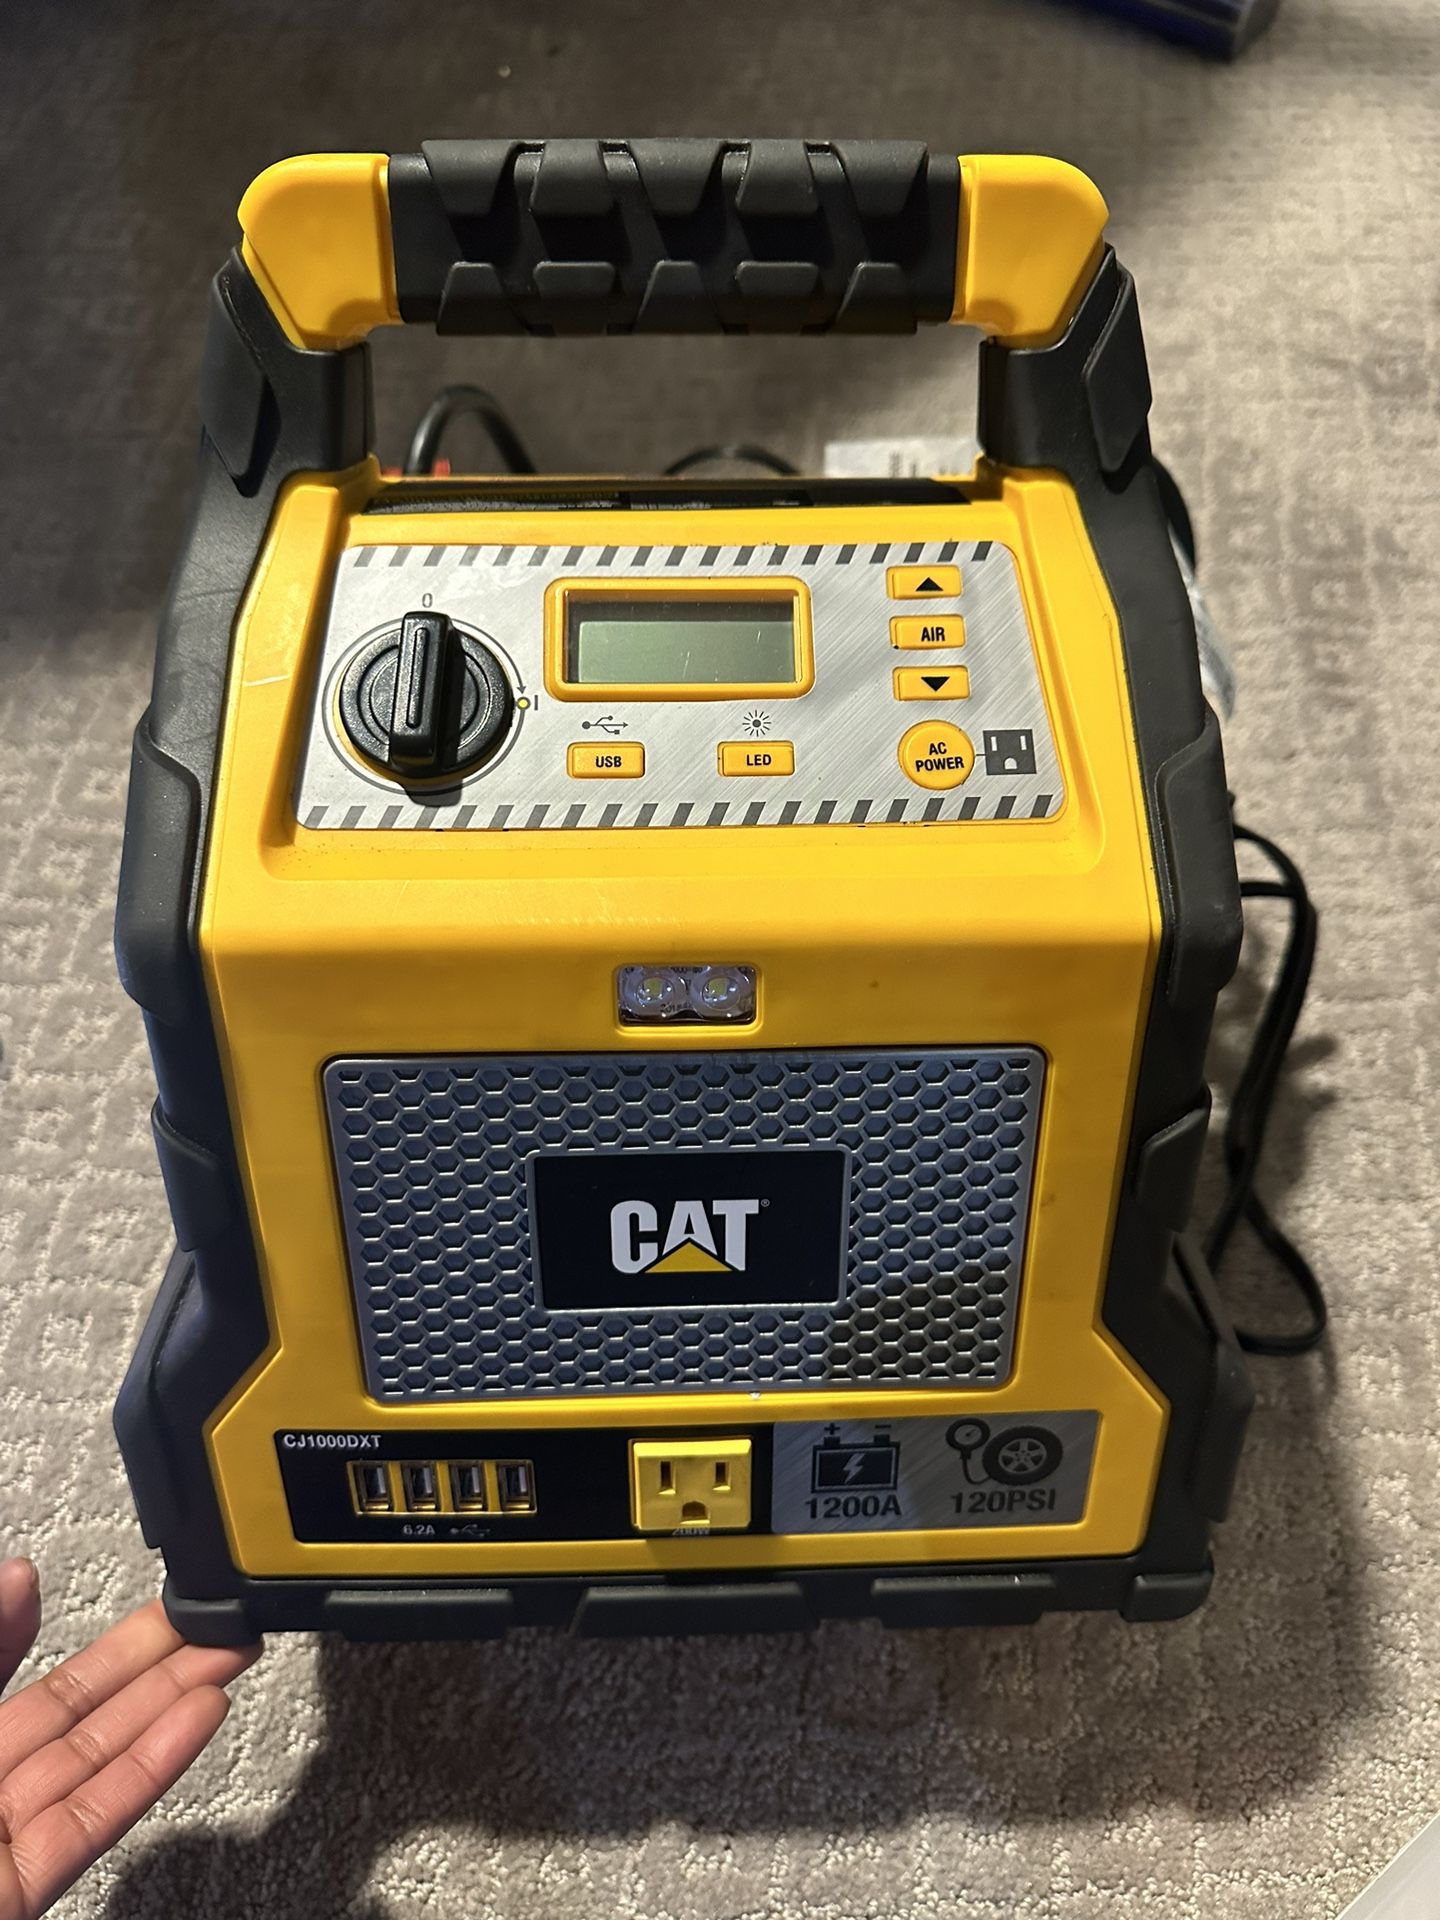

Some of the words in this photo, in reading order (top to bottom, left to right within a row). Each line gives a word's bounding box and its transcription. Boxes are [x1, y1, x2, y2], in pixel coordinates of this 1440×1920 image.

[921, 626, 946, 642] AIR
[928, 742, 947, 755] AC
[595, 755, 622, 768] USB
[746, 754, 772, 767] LED
[915, 756, 965, 773] POWER
[610, 1199, 759, 1274] CAT
[283, 1433, 382, 1450] CJ1000DXT
[805, 1496, 902, 1520] 1200A
[950, 1488, 1056, 1515] 120PSI
[402, 1524, 436, 1535] 6.2A
